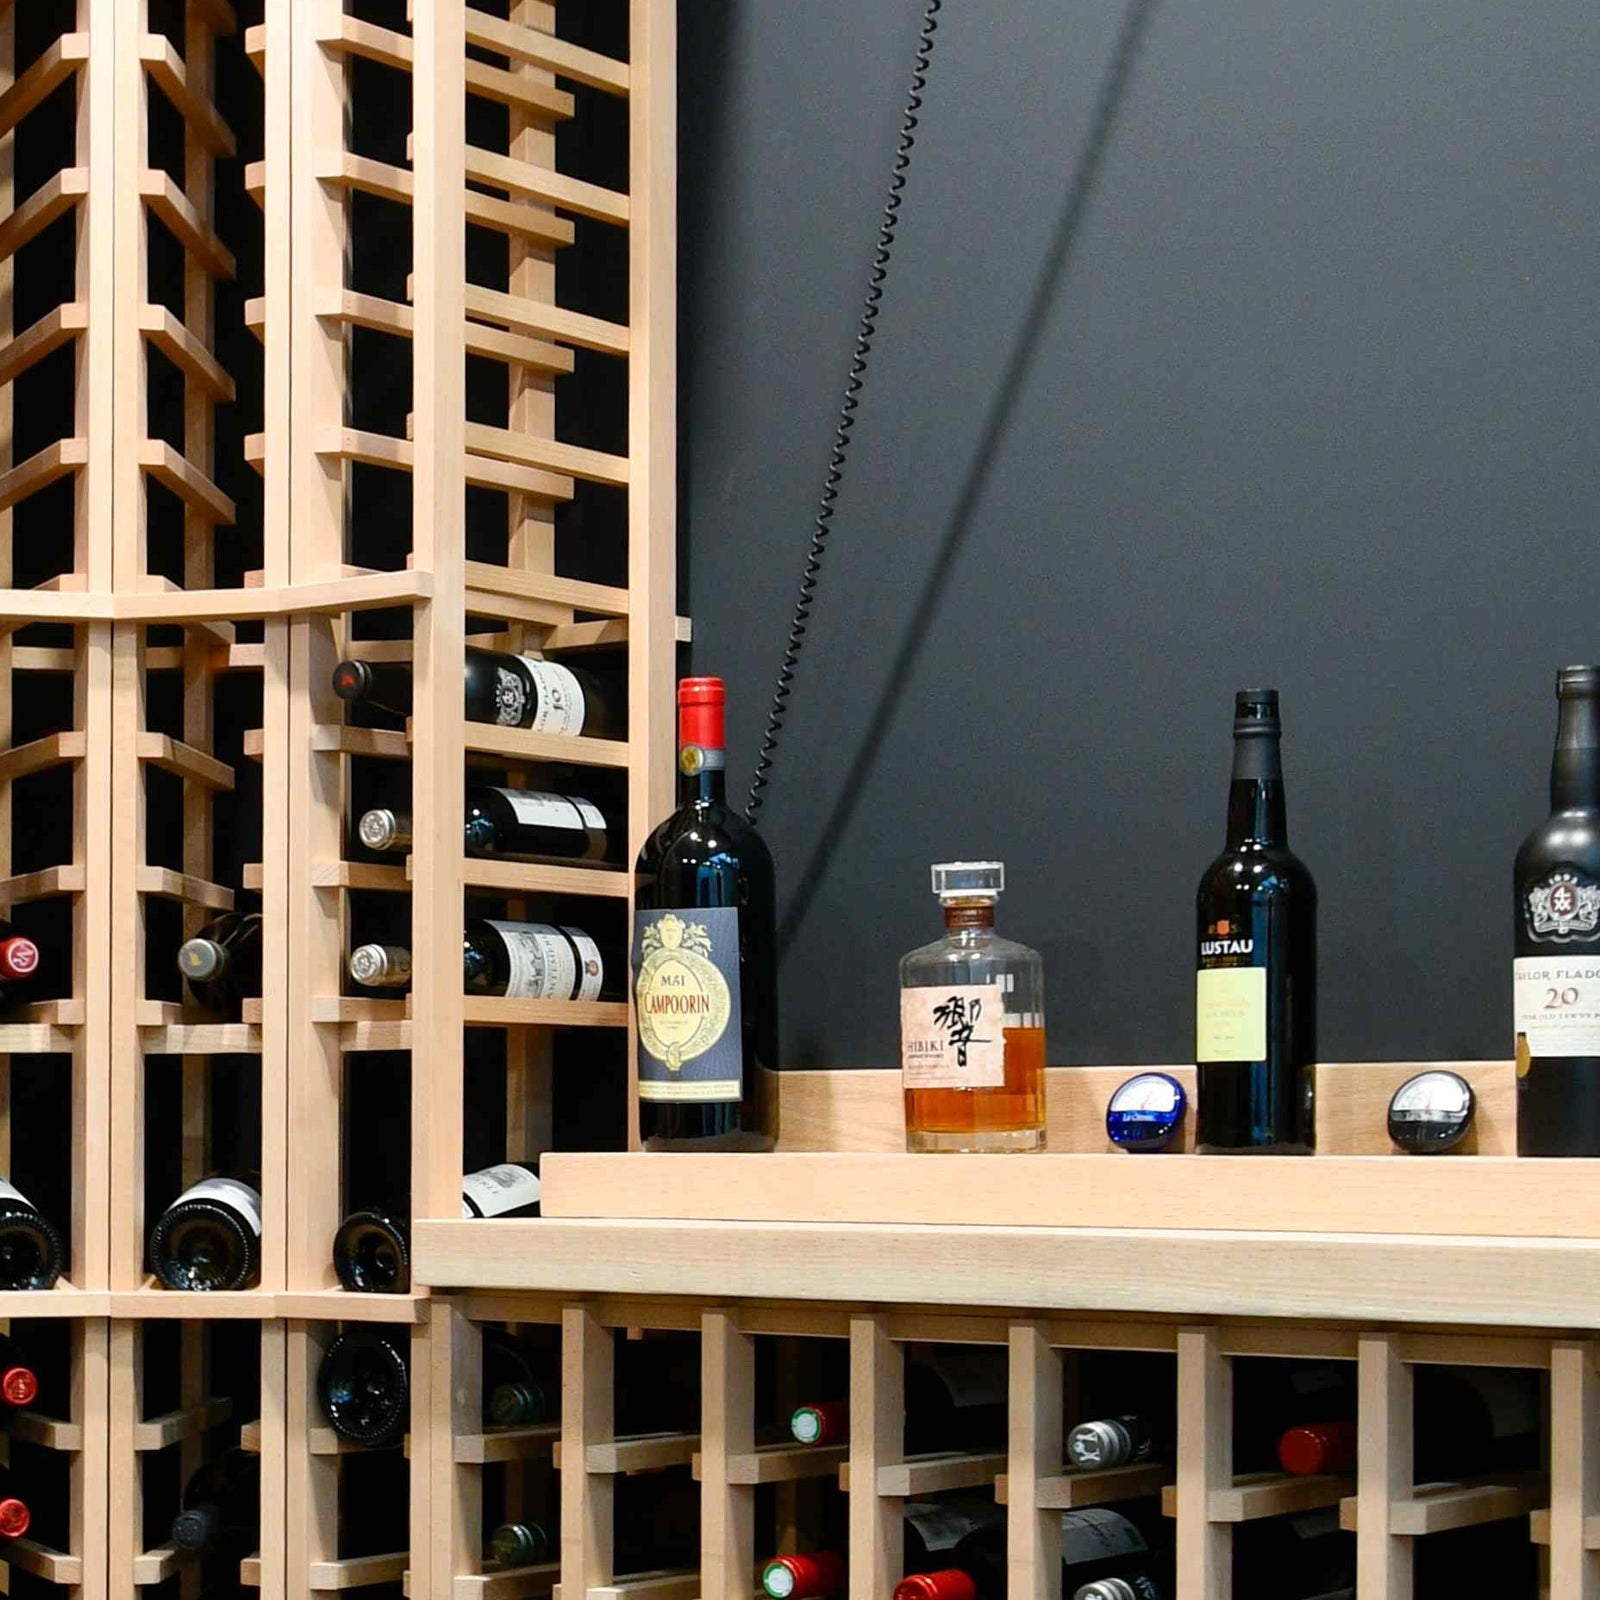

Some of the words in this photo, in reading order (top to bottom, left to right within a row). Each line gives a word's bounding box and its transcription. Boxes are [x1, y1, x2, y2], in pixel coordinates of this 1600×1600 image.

[1201, 939, 1254, 956] LUSTAU
[1544, 987, 1579, 1010] 20
[933, 995, 992, 1068] 響
[907, 1039, 944, 1053] HIBIKI
